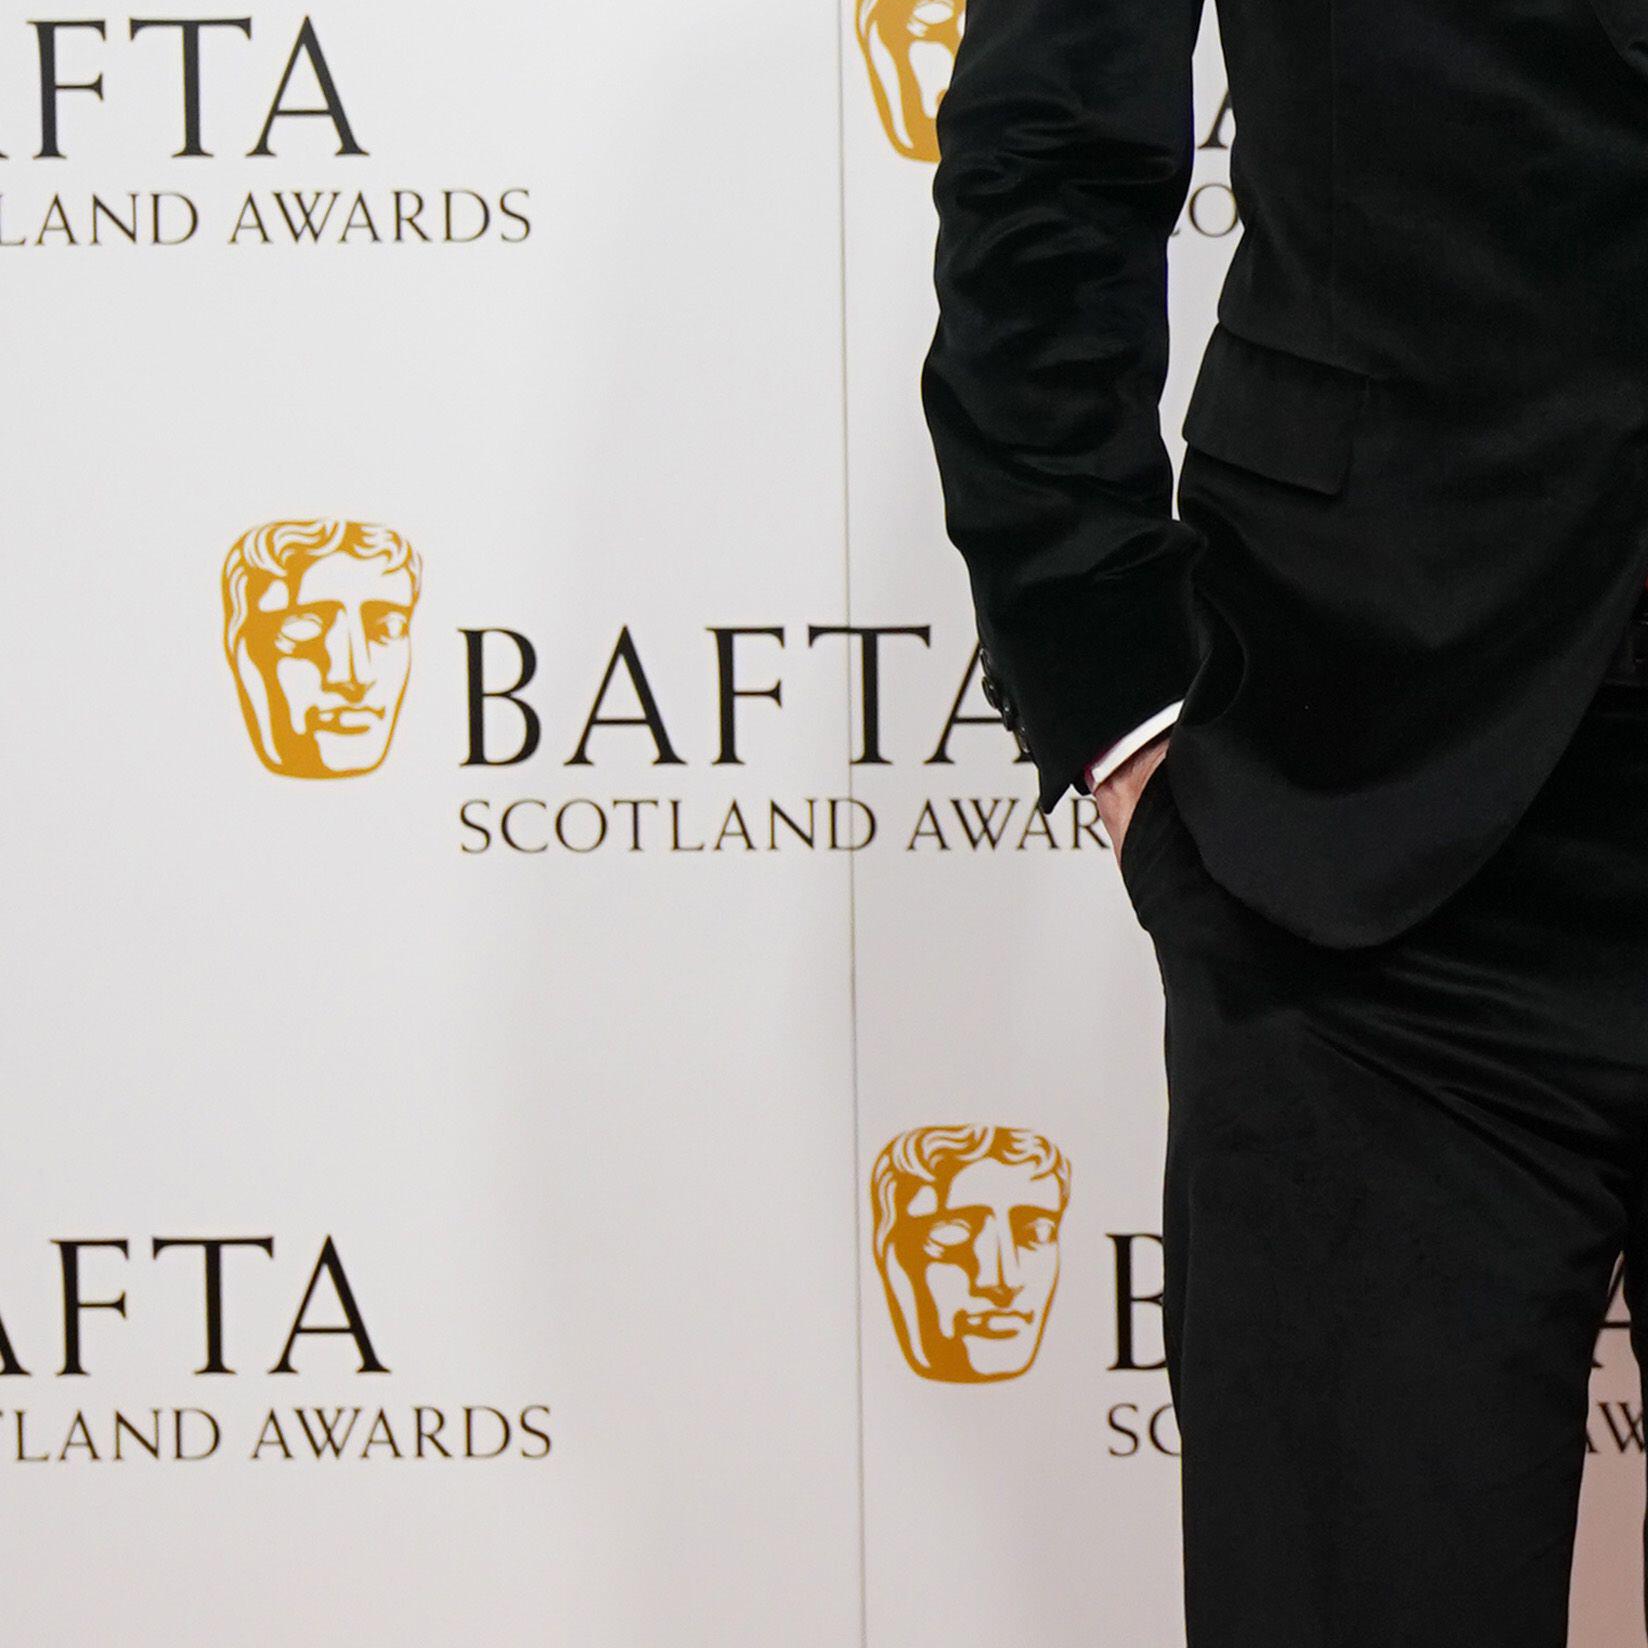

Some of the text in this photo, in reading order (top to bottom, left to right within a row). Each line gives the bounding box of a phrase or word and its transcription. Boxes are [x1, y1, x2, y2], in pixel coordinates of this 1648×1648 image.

[228, 188, 532, 245] AWARDS
[459, 796, 878, 854] SCOTLAND
[250, 1405, 553, 1461] AWARDS
